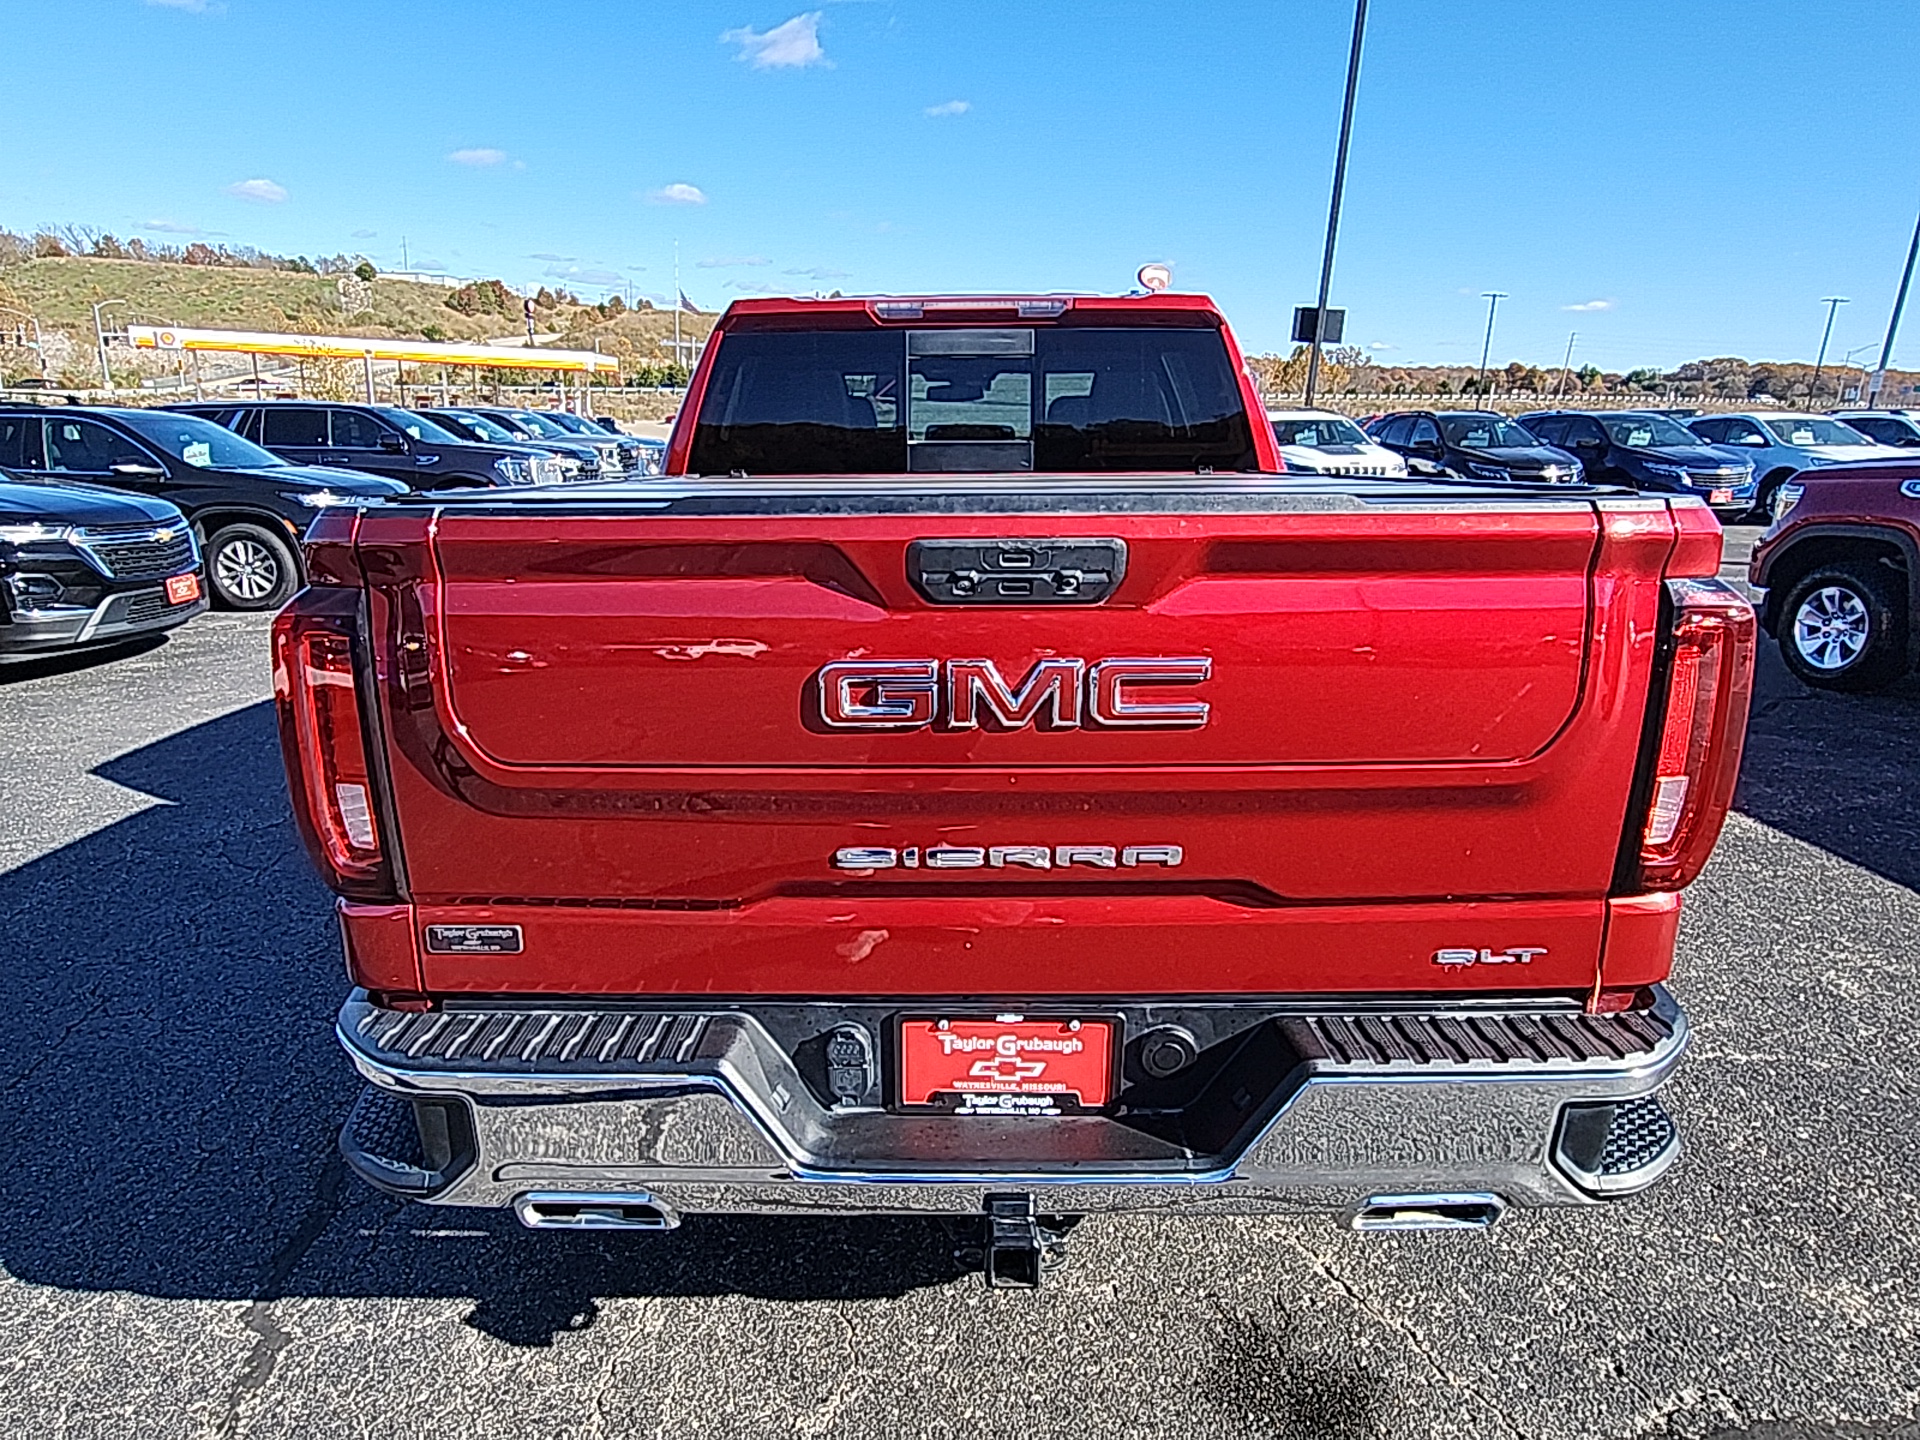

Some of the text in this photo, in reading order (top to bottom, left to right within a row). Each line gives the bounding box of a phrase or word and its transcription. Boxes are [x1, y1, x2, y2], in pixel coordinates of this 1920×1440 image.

[819, 657, 1211, 728] GMC
[835, 845, 1183, 869] SIERRA
[433, 928, 465, 940] Taylor
[1437, 948, 1548, 963] SLT
[938, 1034, 1083, 1055] Taylor Grubaugh
[1022, 1082, 1066, 1091] MISSOURI
[962, 1094, 1054, 1108] Taylor Grubaugh
